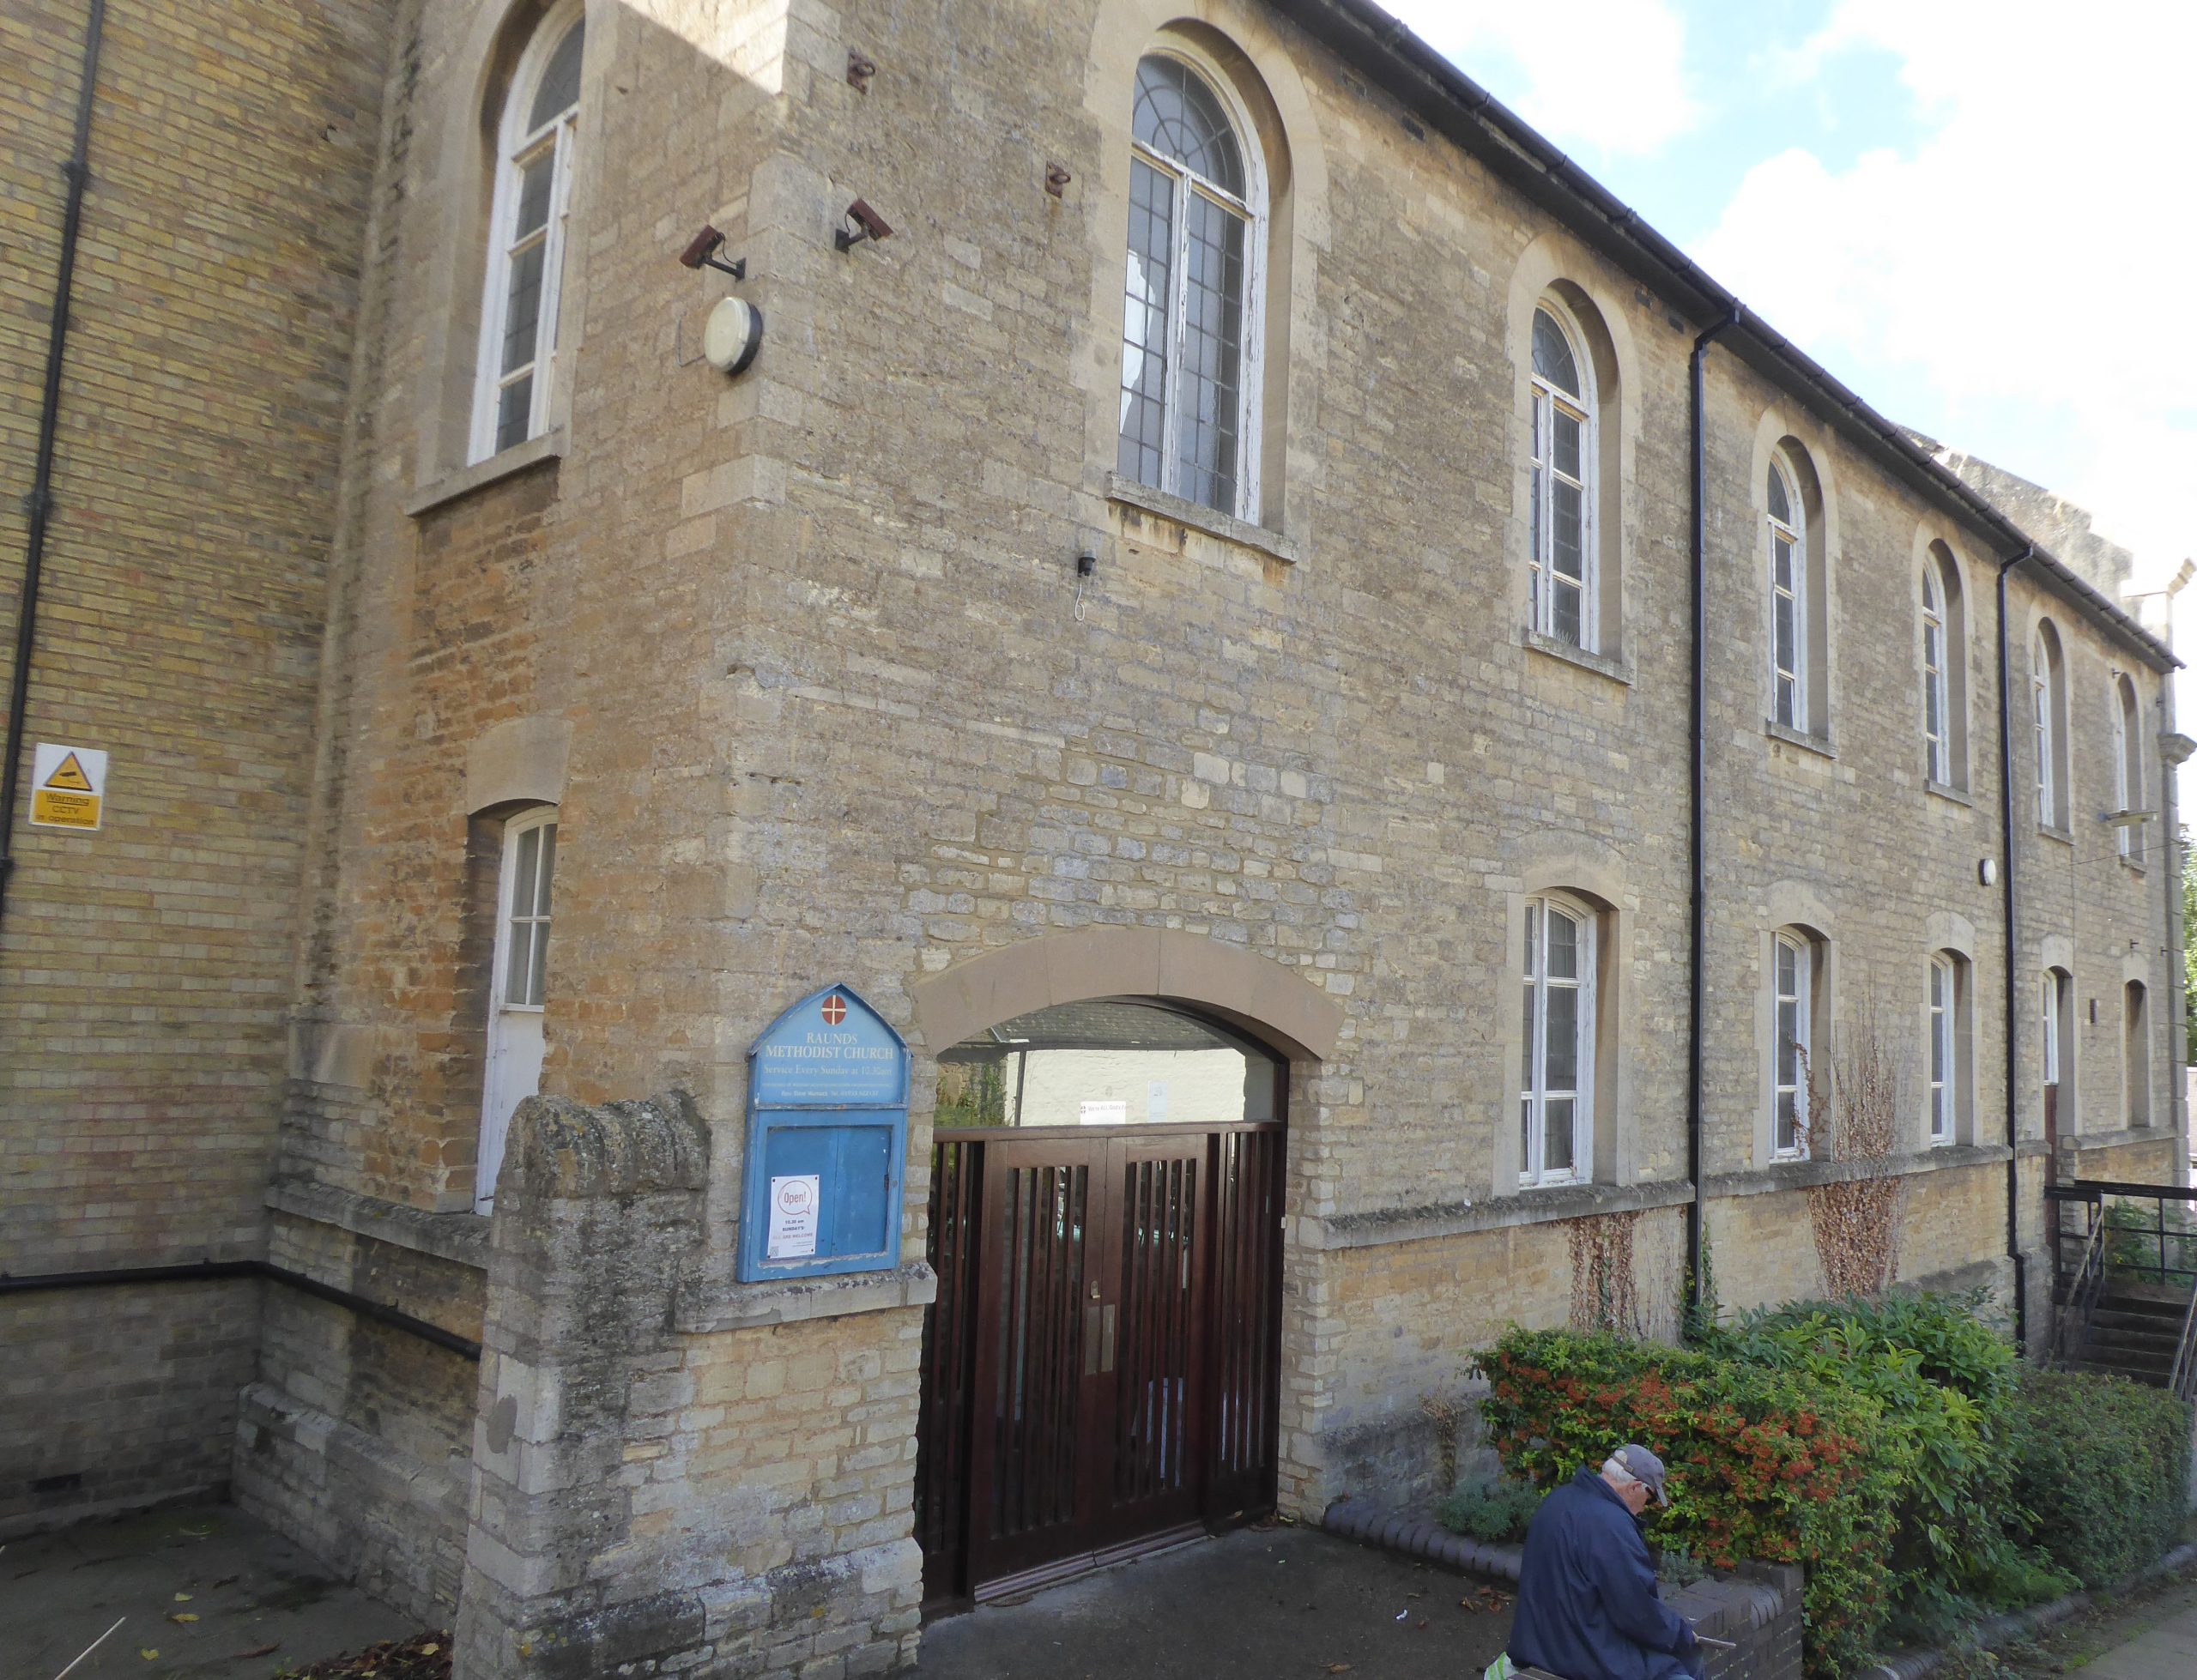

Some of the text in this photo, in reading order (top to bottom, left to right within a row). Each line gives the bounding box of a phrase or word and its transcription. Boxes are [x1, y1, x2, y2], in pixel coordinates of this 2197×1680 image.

[45, 793, 89, 806] Warning
[52, 806, 79, 814] CCTV
[49, 815, 94, 825] operation
[807, 1032, 857, 1044] RAUNDS
[766, 1045, 893, 1060] METHODIST CHURCH
[763, 1064, 793, 1074] Service
[796, 1064, 818, 1076] Every
[820, 1065, 849, 1076] Sunday
[850, 1067, 859, 1075] at
[784, 1191, 807, 1206] Open!
